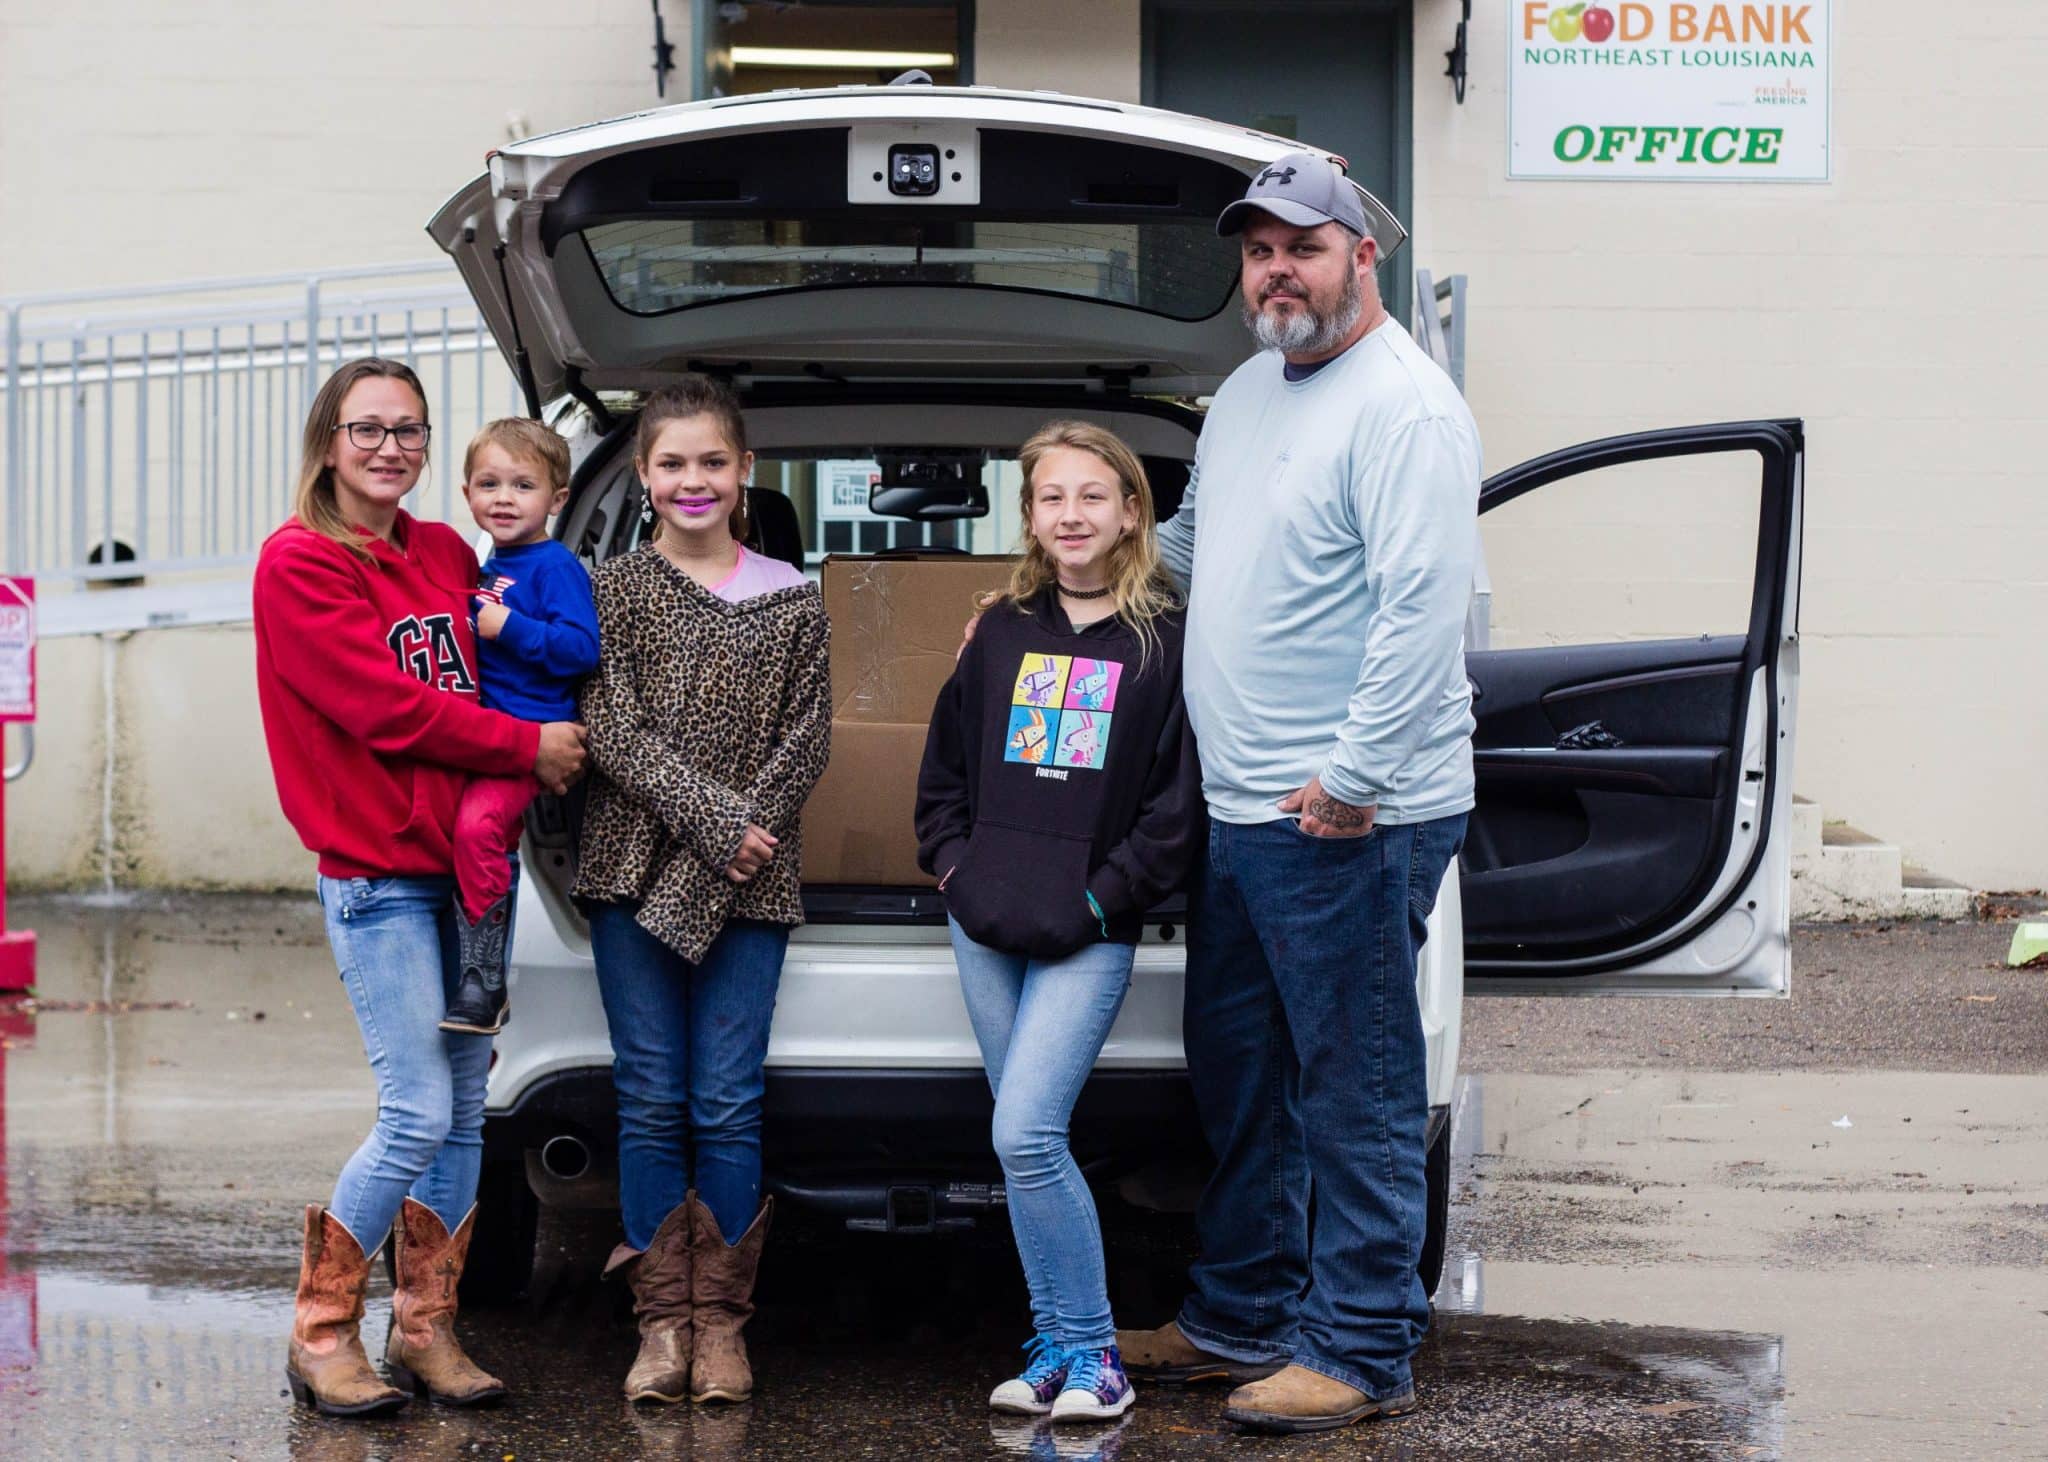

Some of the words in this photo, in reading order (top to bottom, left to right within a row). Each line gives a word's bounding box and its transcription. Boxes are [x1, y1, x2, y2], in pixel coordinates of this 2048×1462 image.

[1669, 3, 1813, 44] BANK
[1524, 48, 1673, 66] NORTHEAST
[1682, 49, 1815, 68] LOUISIANA
[1754, 80, 1808, 96] FEEDING
[1754, 96, 1807, 105] AMERICA
[1553, 124, 1784, 164] OFFICE
